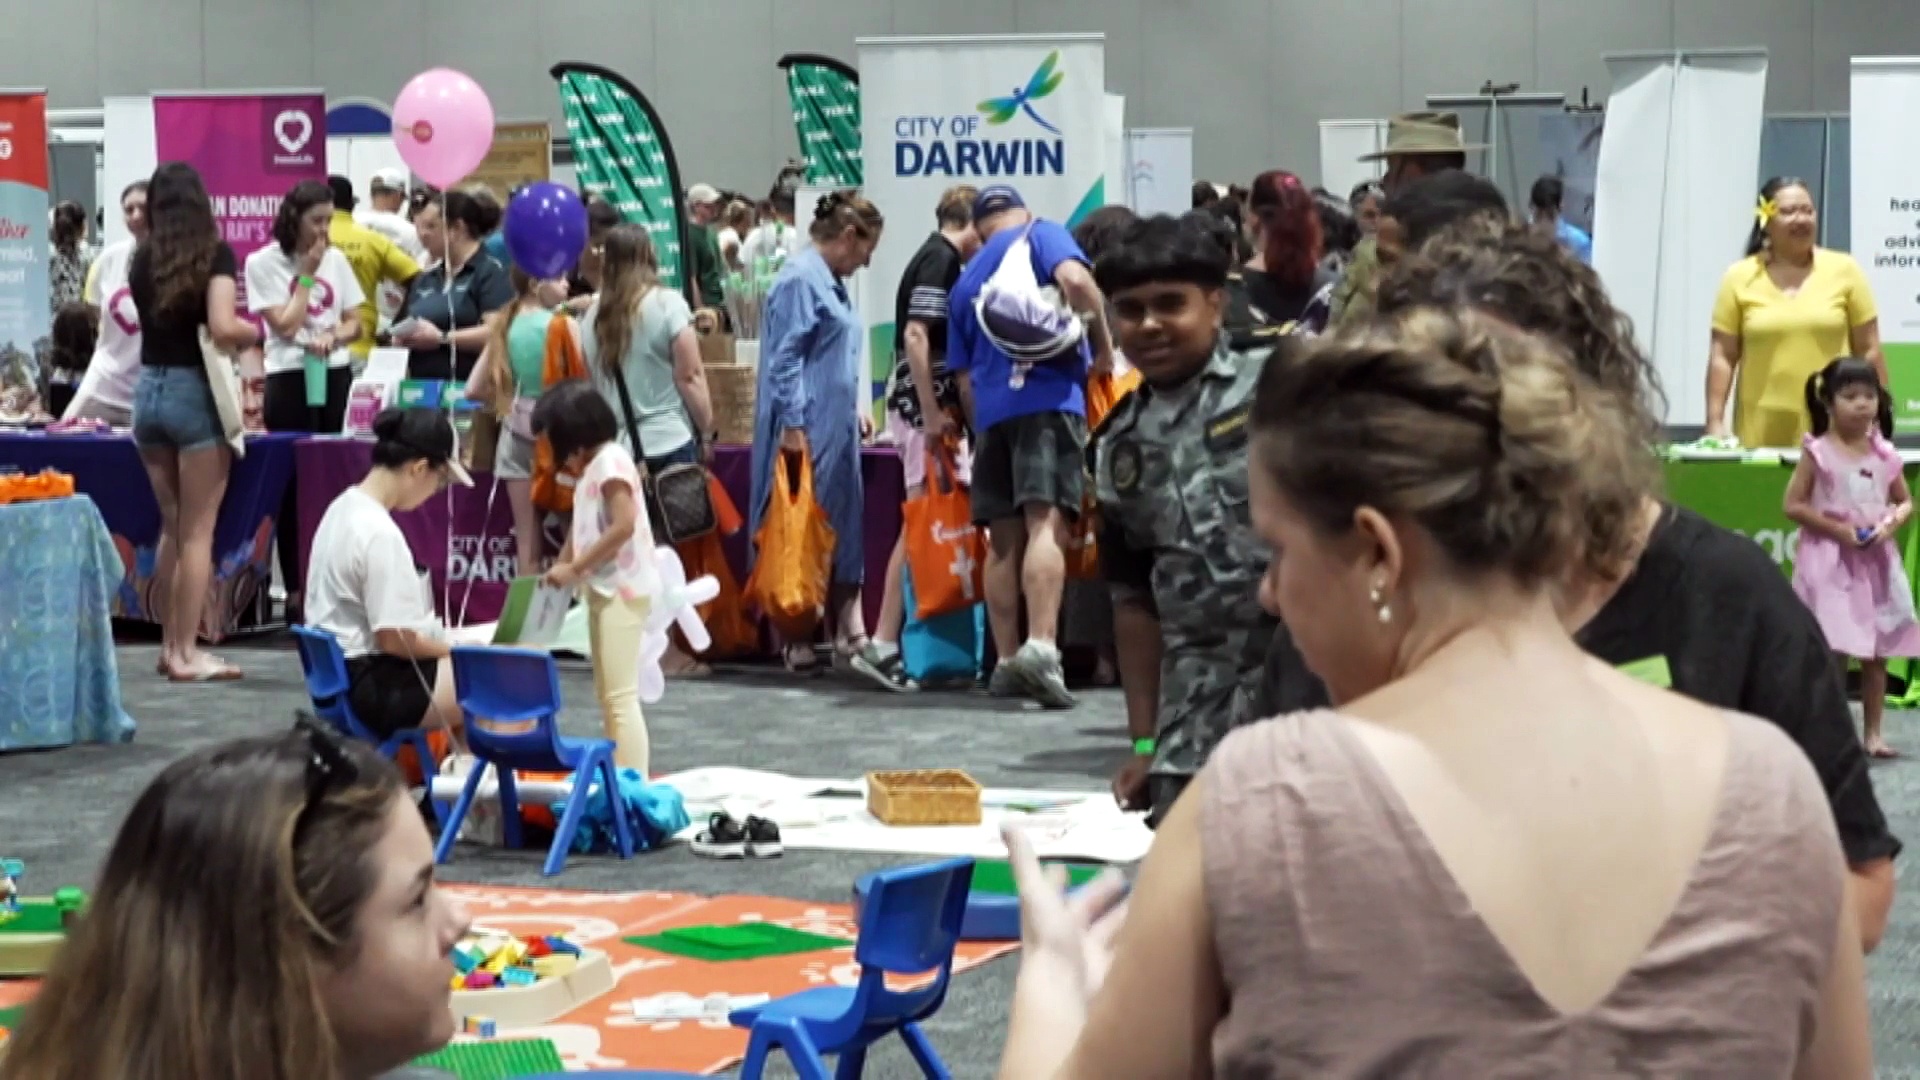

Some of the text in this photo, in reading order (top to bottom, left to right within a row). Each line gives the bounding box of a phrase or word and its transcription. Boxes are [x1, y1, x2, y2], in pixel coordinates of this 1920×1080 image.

[896, 115, 979, 137] CITY OF
[896, 140, 1064, 176] DARWIN
[449, 536, 511, 551] CITY OF
[448, 555, 517, 580] DAR
